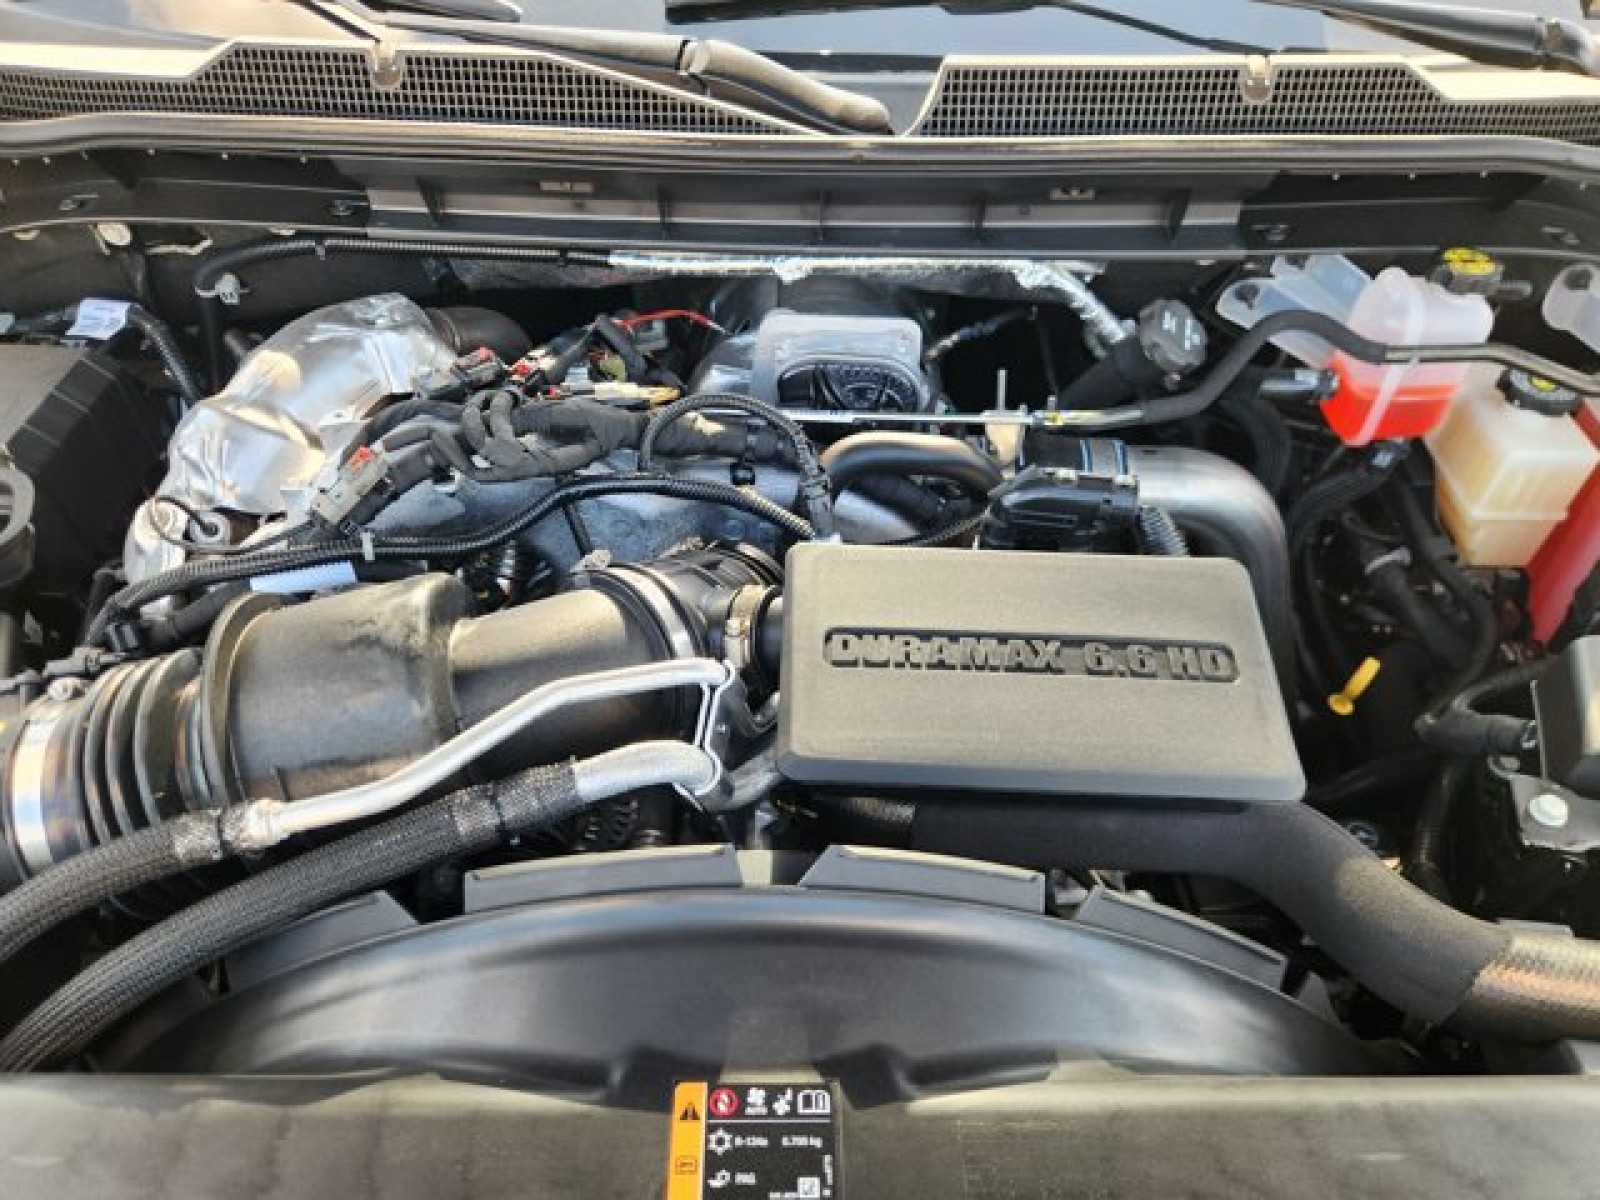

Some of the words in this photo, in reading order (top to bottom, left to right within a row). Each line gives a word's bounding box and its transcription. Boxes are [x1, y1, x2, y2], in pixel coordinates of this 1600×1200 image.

[829, 634, 1065, 673] DURAMAX
[1084, 641, 1157, 677] 6.6
[1167, 646, 1235, 682] HD
